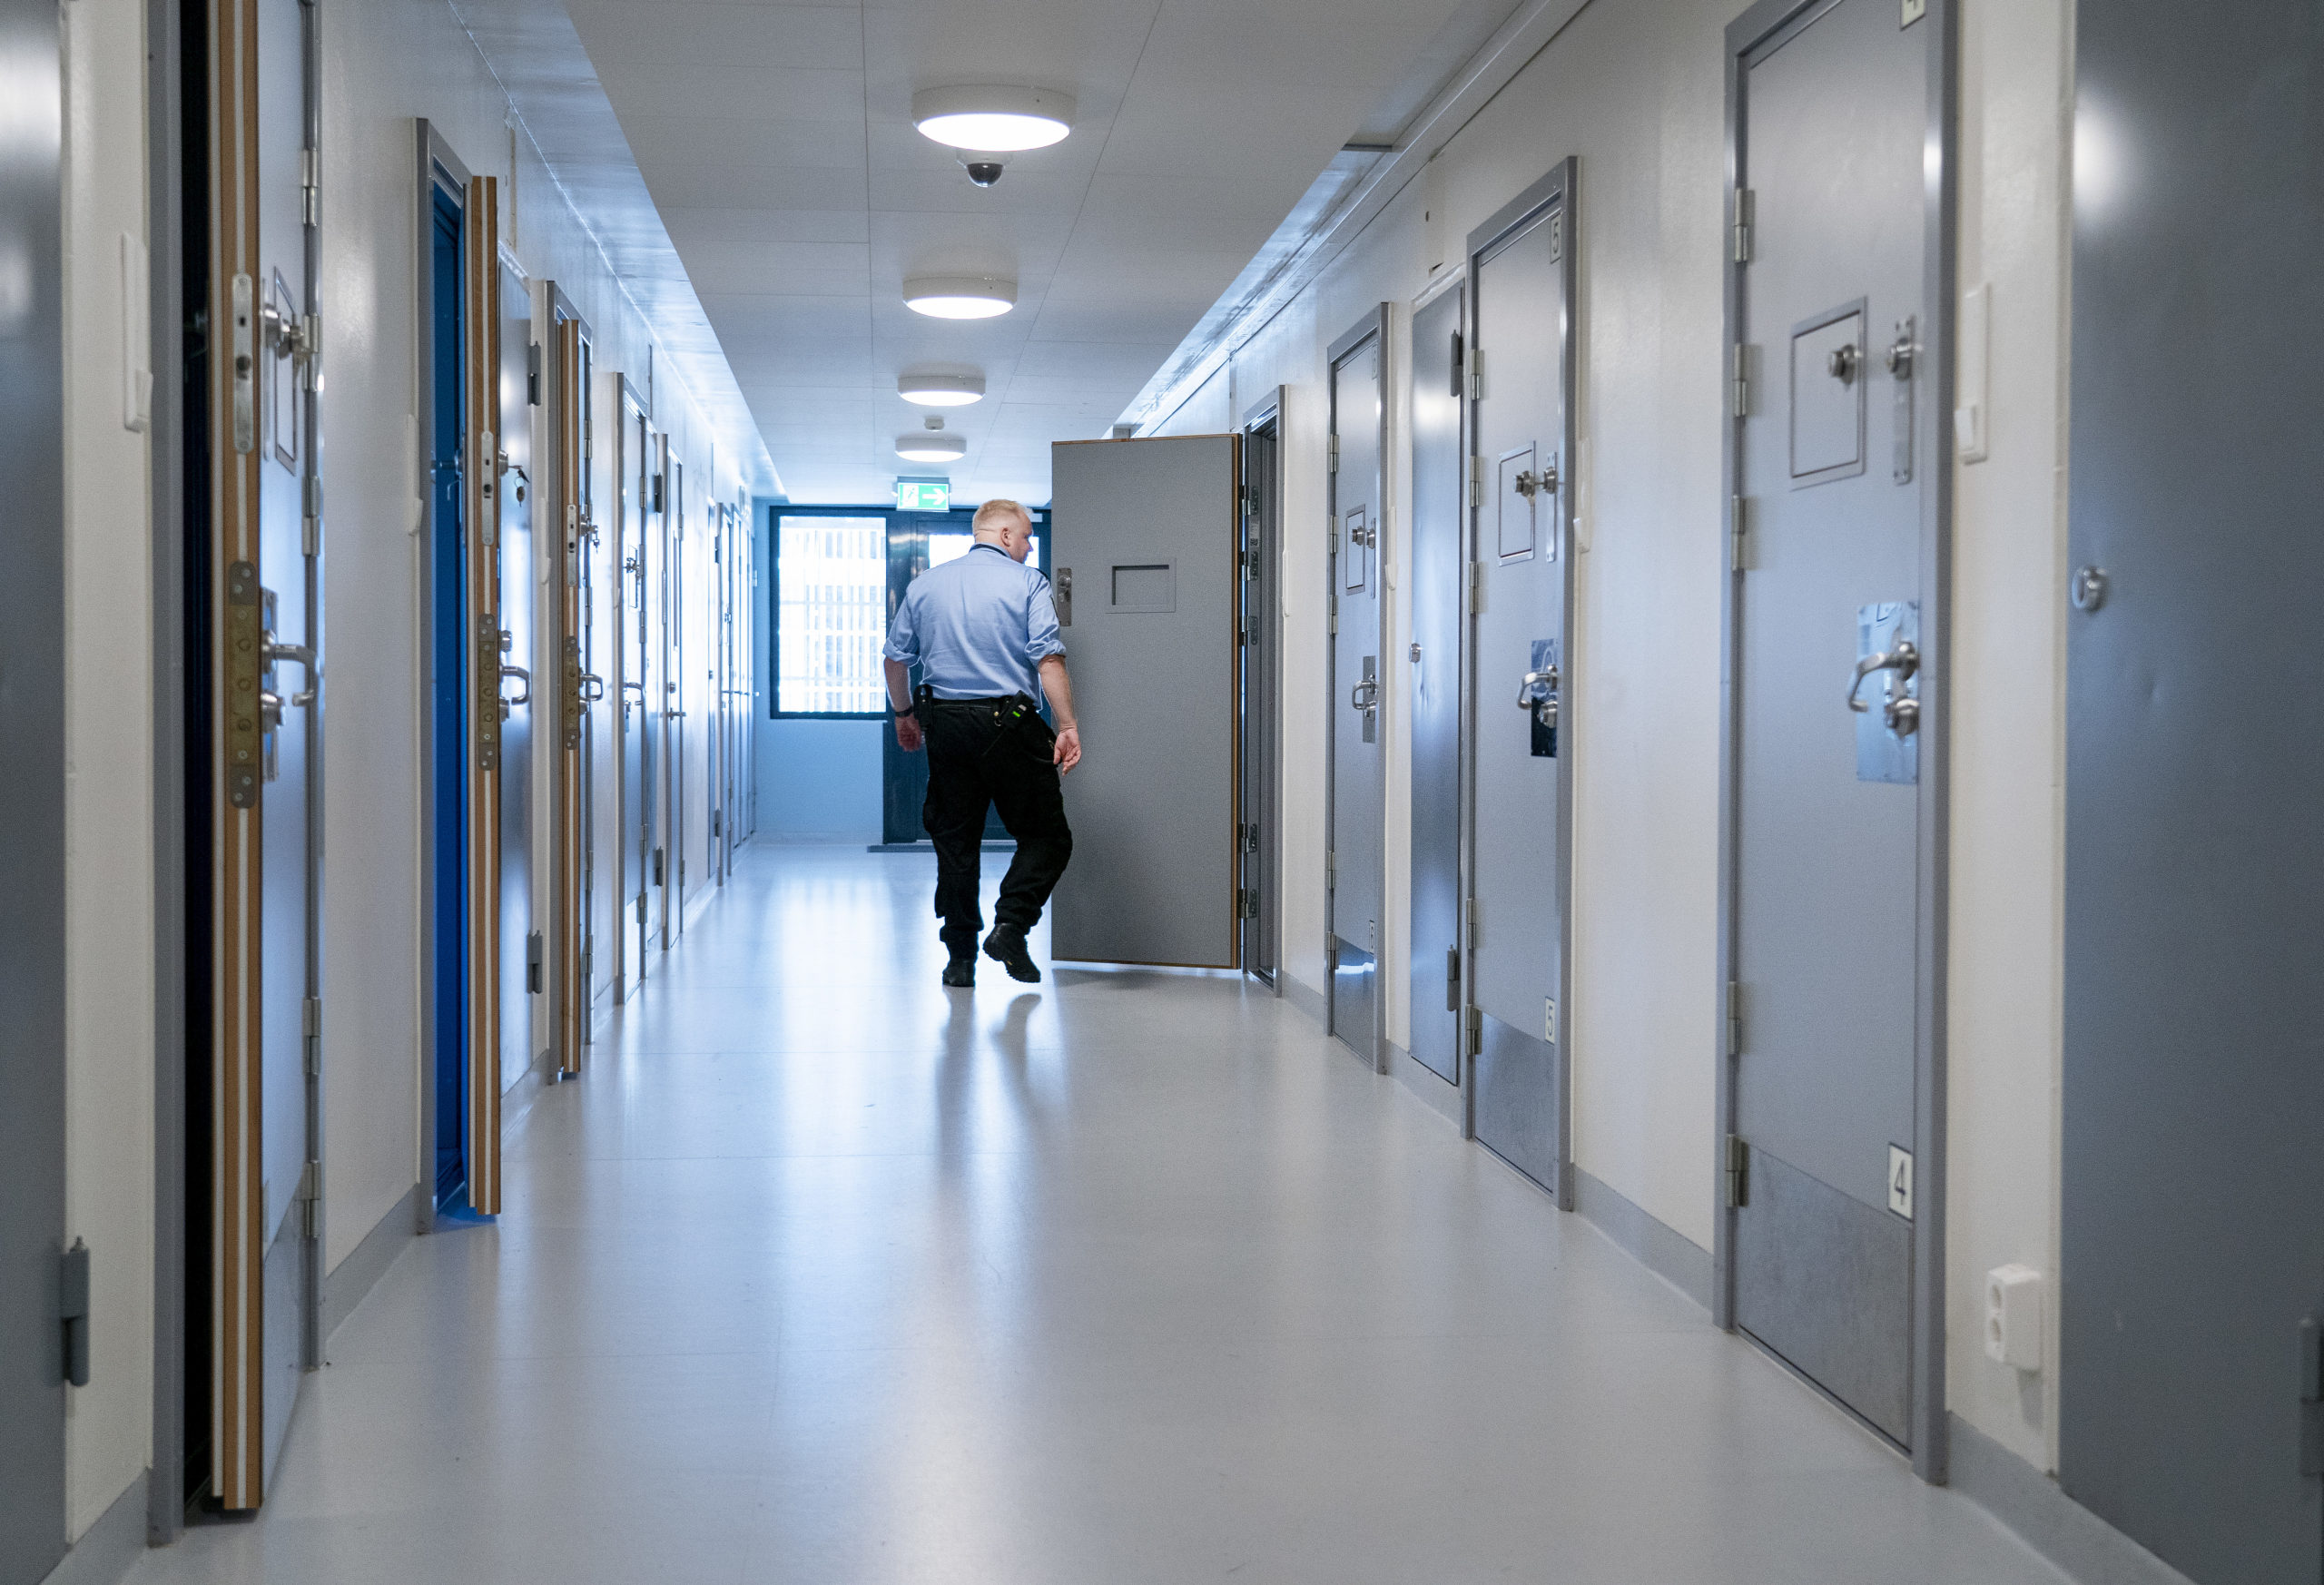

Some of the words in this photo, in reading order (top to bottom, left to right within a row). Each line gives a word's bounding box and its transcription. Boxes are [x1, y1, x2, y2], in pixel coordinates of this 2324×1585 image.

[1553, 222, 1560, 254] 5
[1548, 1004, 1554, 1037] 5
[1894, 1158, 1906, 1206] 4
